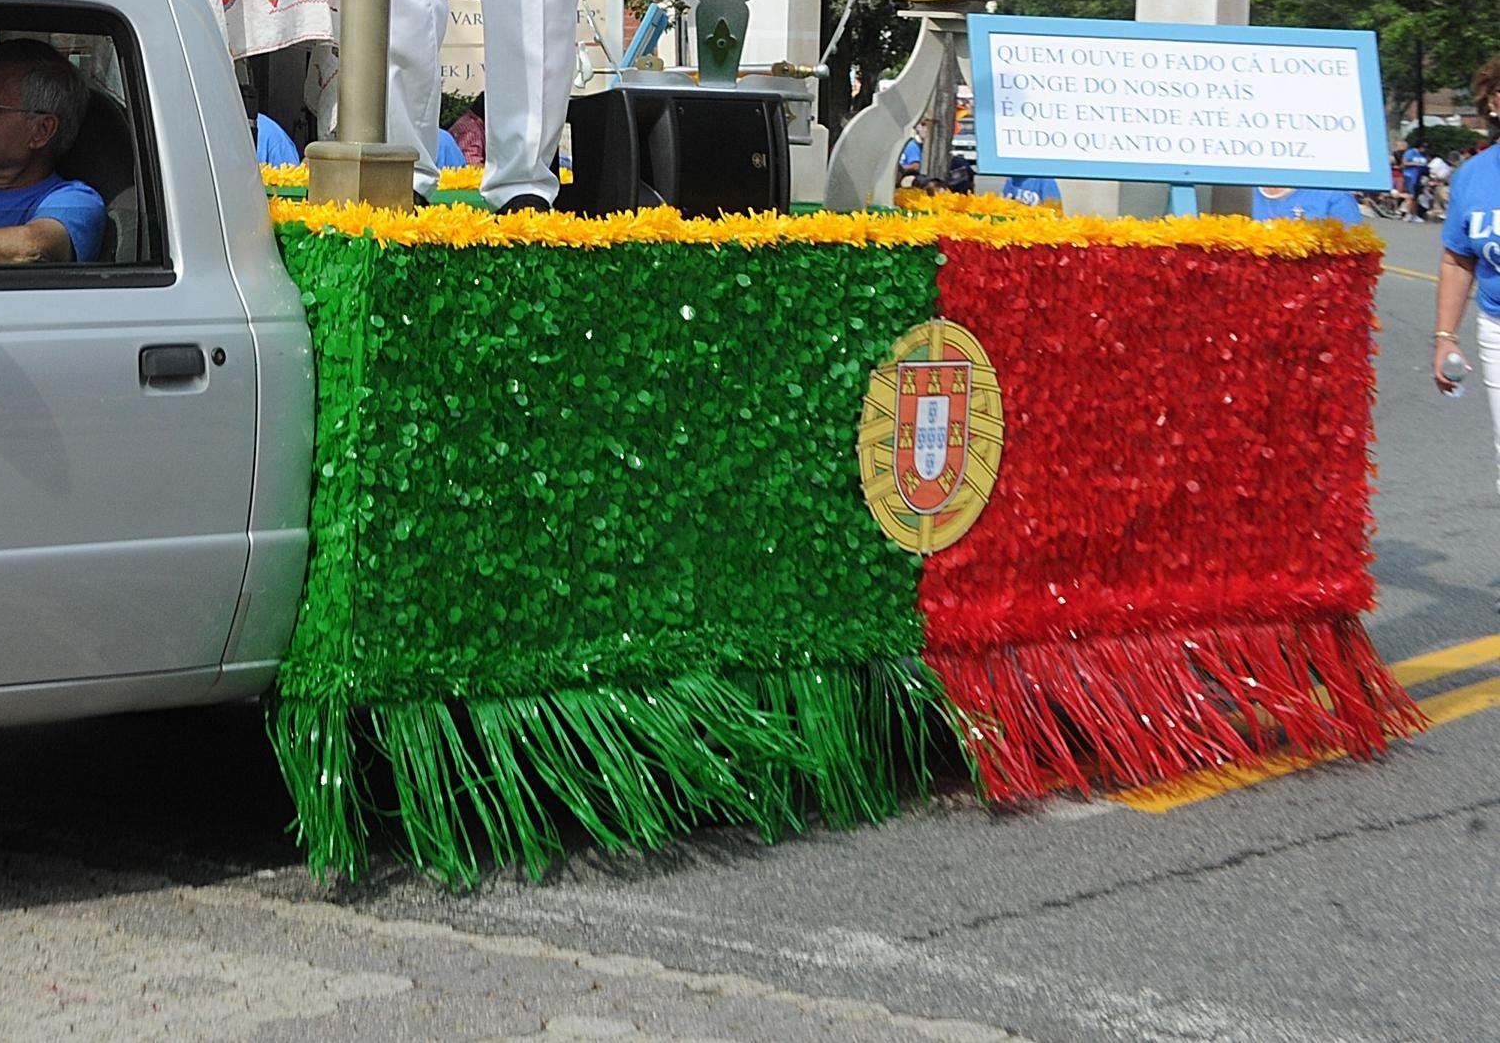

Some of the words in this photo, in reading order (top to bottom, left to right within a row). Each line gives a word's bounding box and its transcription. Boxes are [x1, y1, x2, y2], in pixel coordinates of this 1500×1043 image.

[997, 45, 1064, 64] QUEM
[1071, 48, 1135, 68] OUVE
[1142, 53, 1158, 69] O
[1165, 54, 1225, 71] FADO
[1271, 57, 1349, 76] LONGE
[1000, 73, 1077, 92] LONGE
[1085, 77, 1116, 94] DO
[1124, 79, 1199, 98] NOSSO
[1206, 79, 1254, 100] PAÍS
[1001, 96, 1014, 117] É
[1020, 101, 1068, 122] QUE
[1076, 104, 1182, 125] ENTENDE
[1189, 107, 1230, 127] ATÉ
[1236, 112, 1269, 128] AO
[1276, 113, 1356, 132] FUNDO
[1002, 128, 1067, 147] TUDO
[1074, 132, 1172, 152] QUANTO
[1178, 137, 1195, 154] O
[1203, 138, 1264, 156] FADO
[1271, 141, 1316, 158] DIZ.
